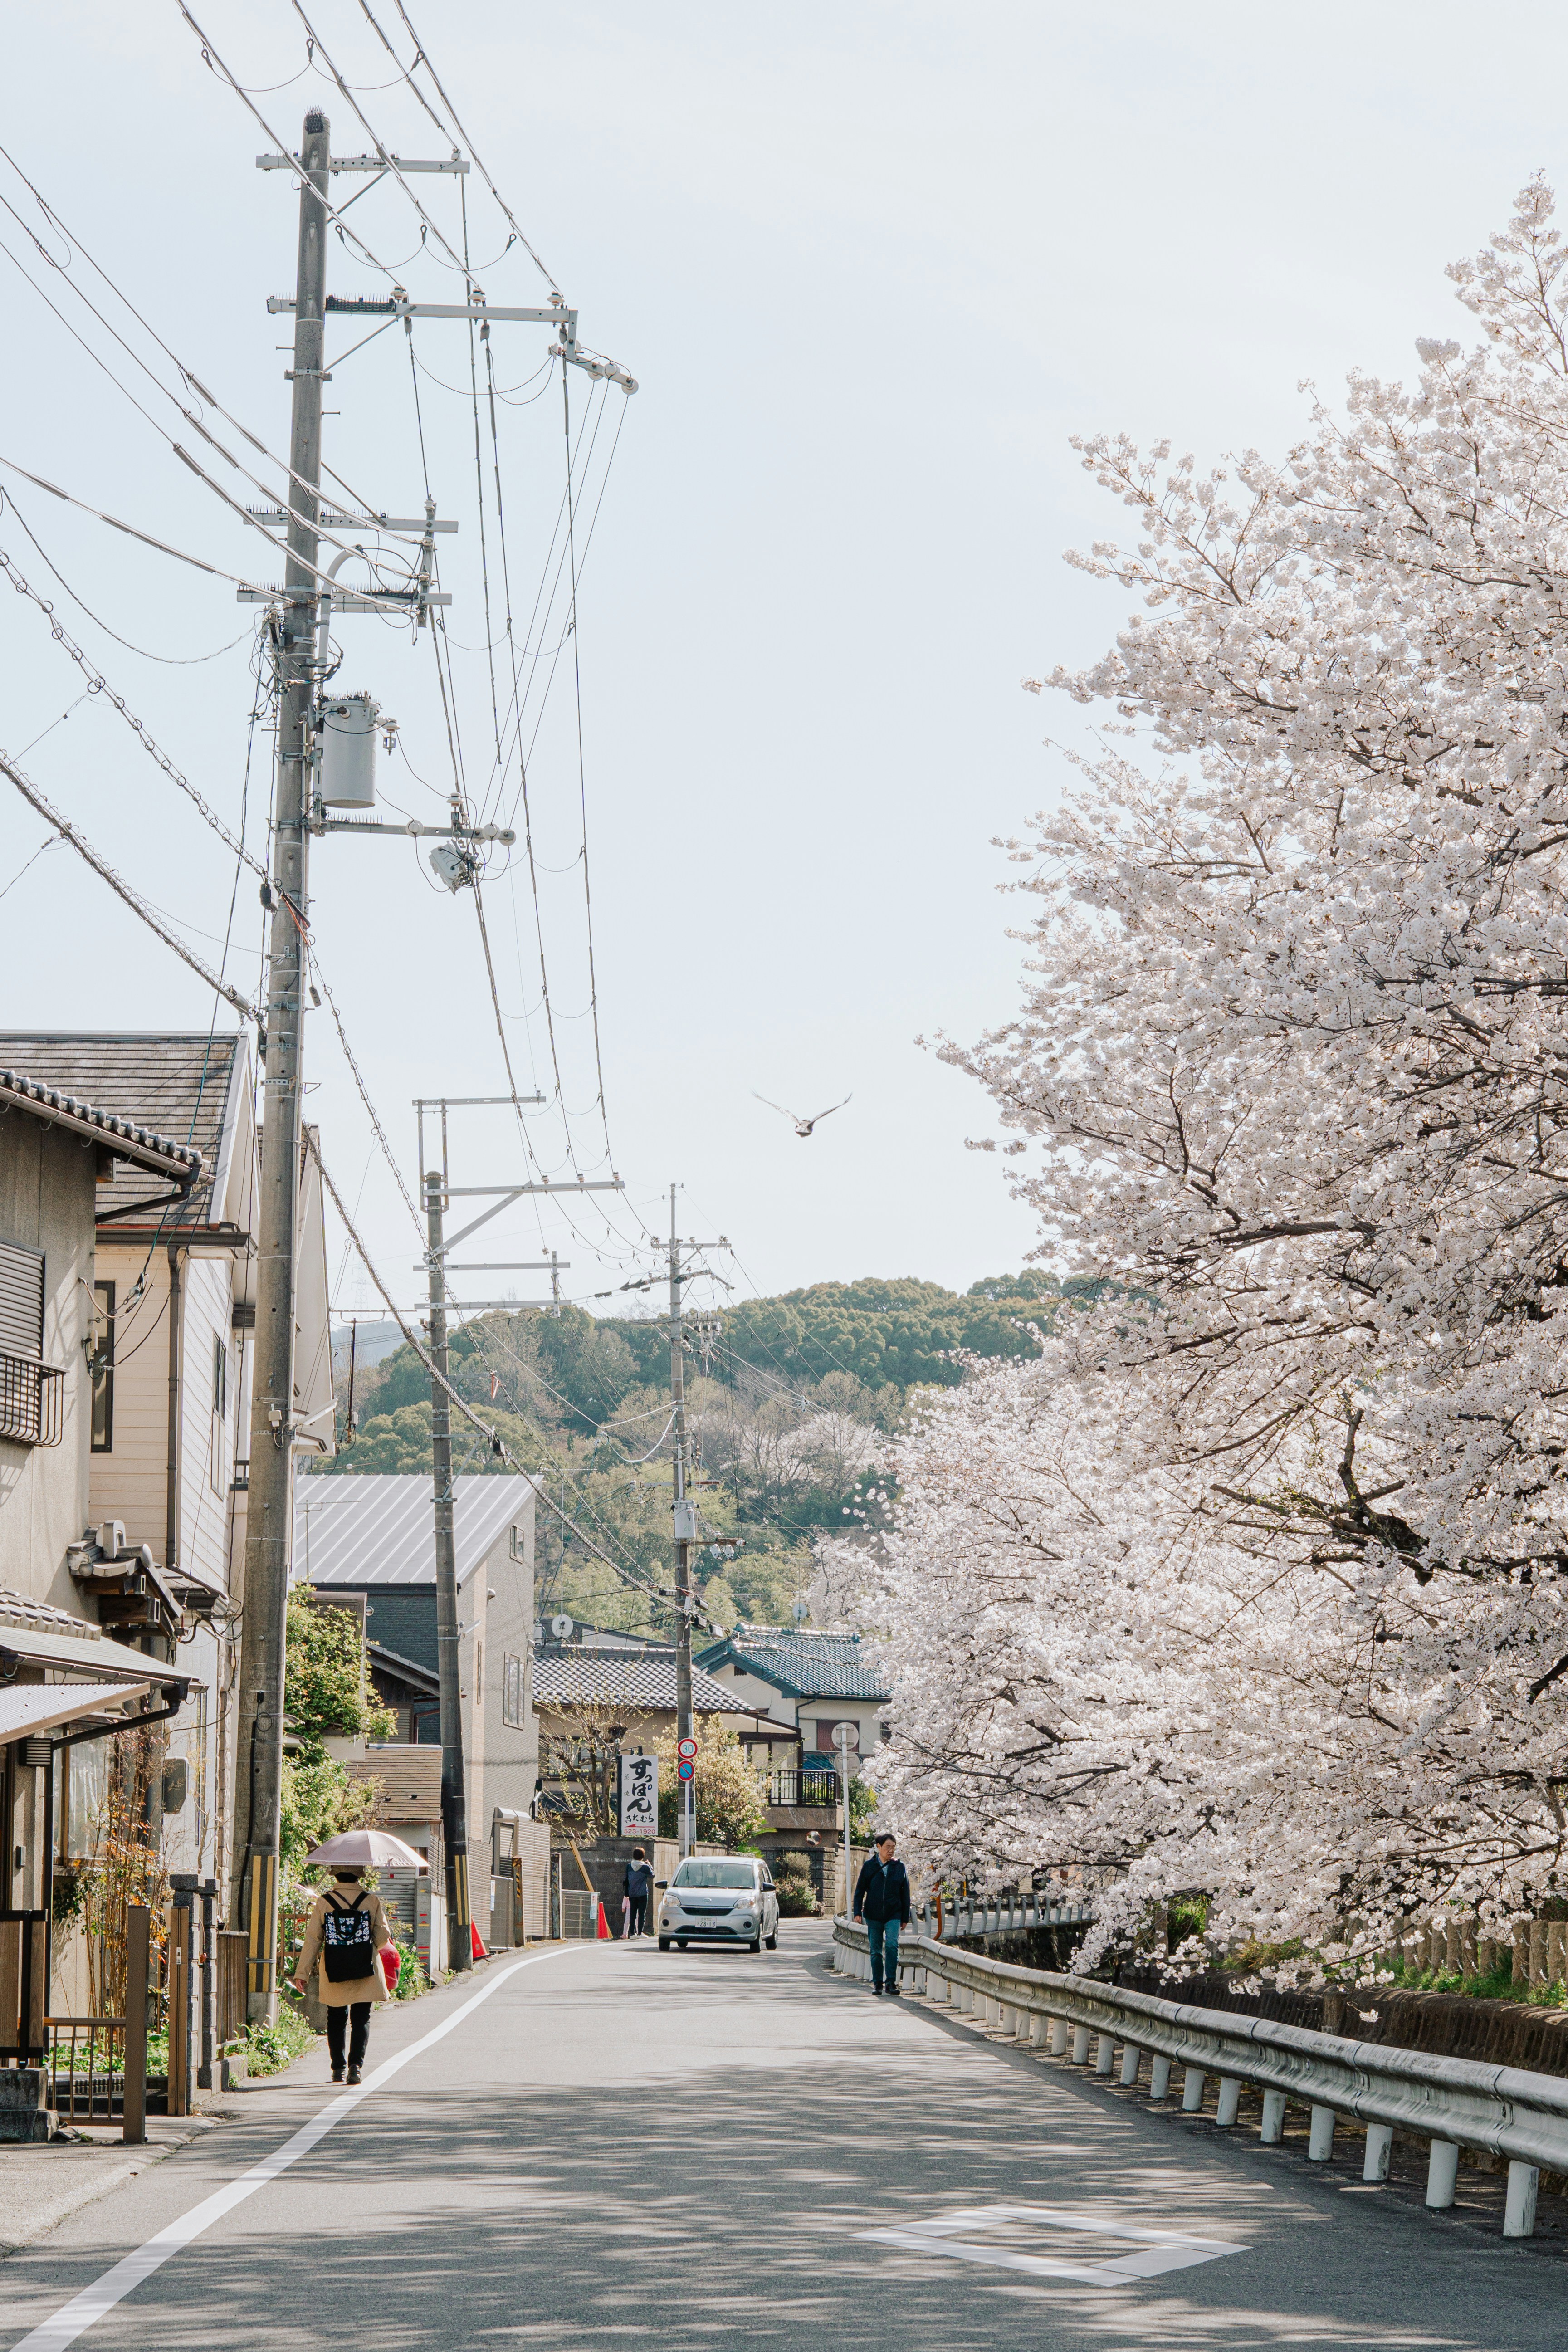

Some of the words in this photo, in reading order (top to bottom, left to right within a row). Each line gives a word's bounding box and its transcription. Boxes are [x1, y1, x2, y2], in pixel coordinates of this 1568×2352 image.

[683, 1744, 694, 1753] 30
[627, 1758, 653, 1813] すっぽん
[625, 1813, 654, 1823] きたむら
